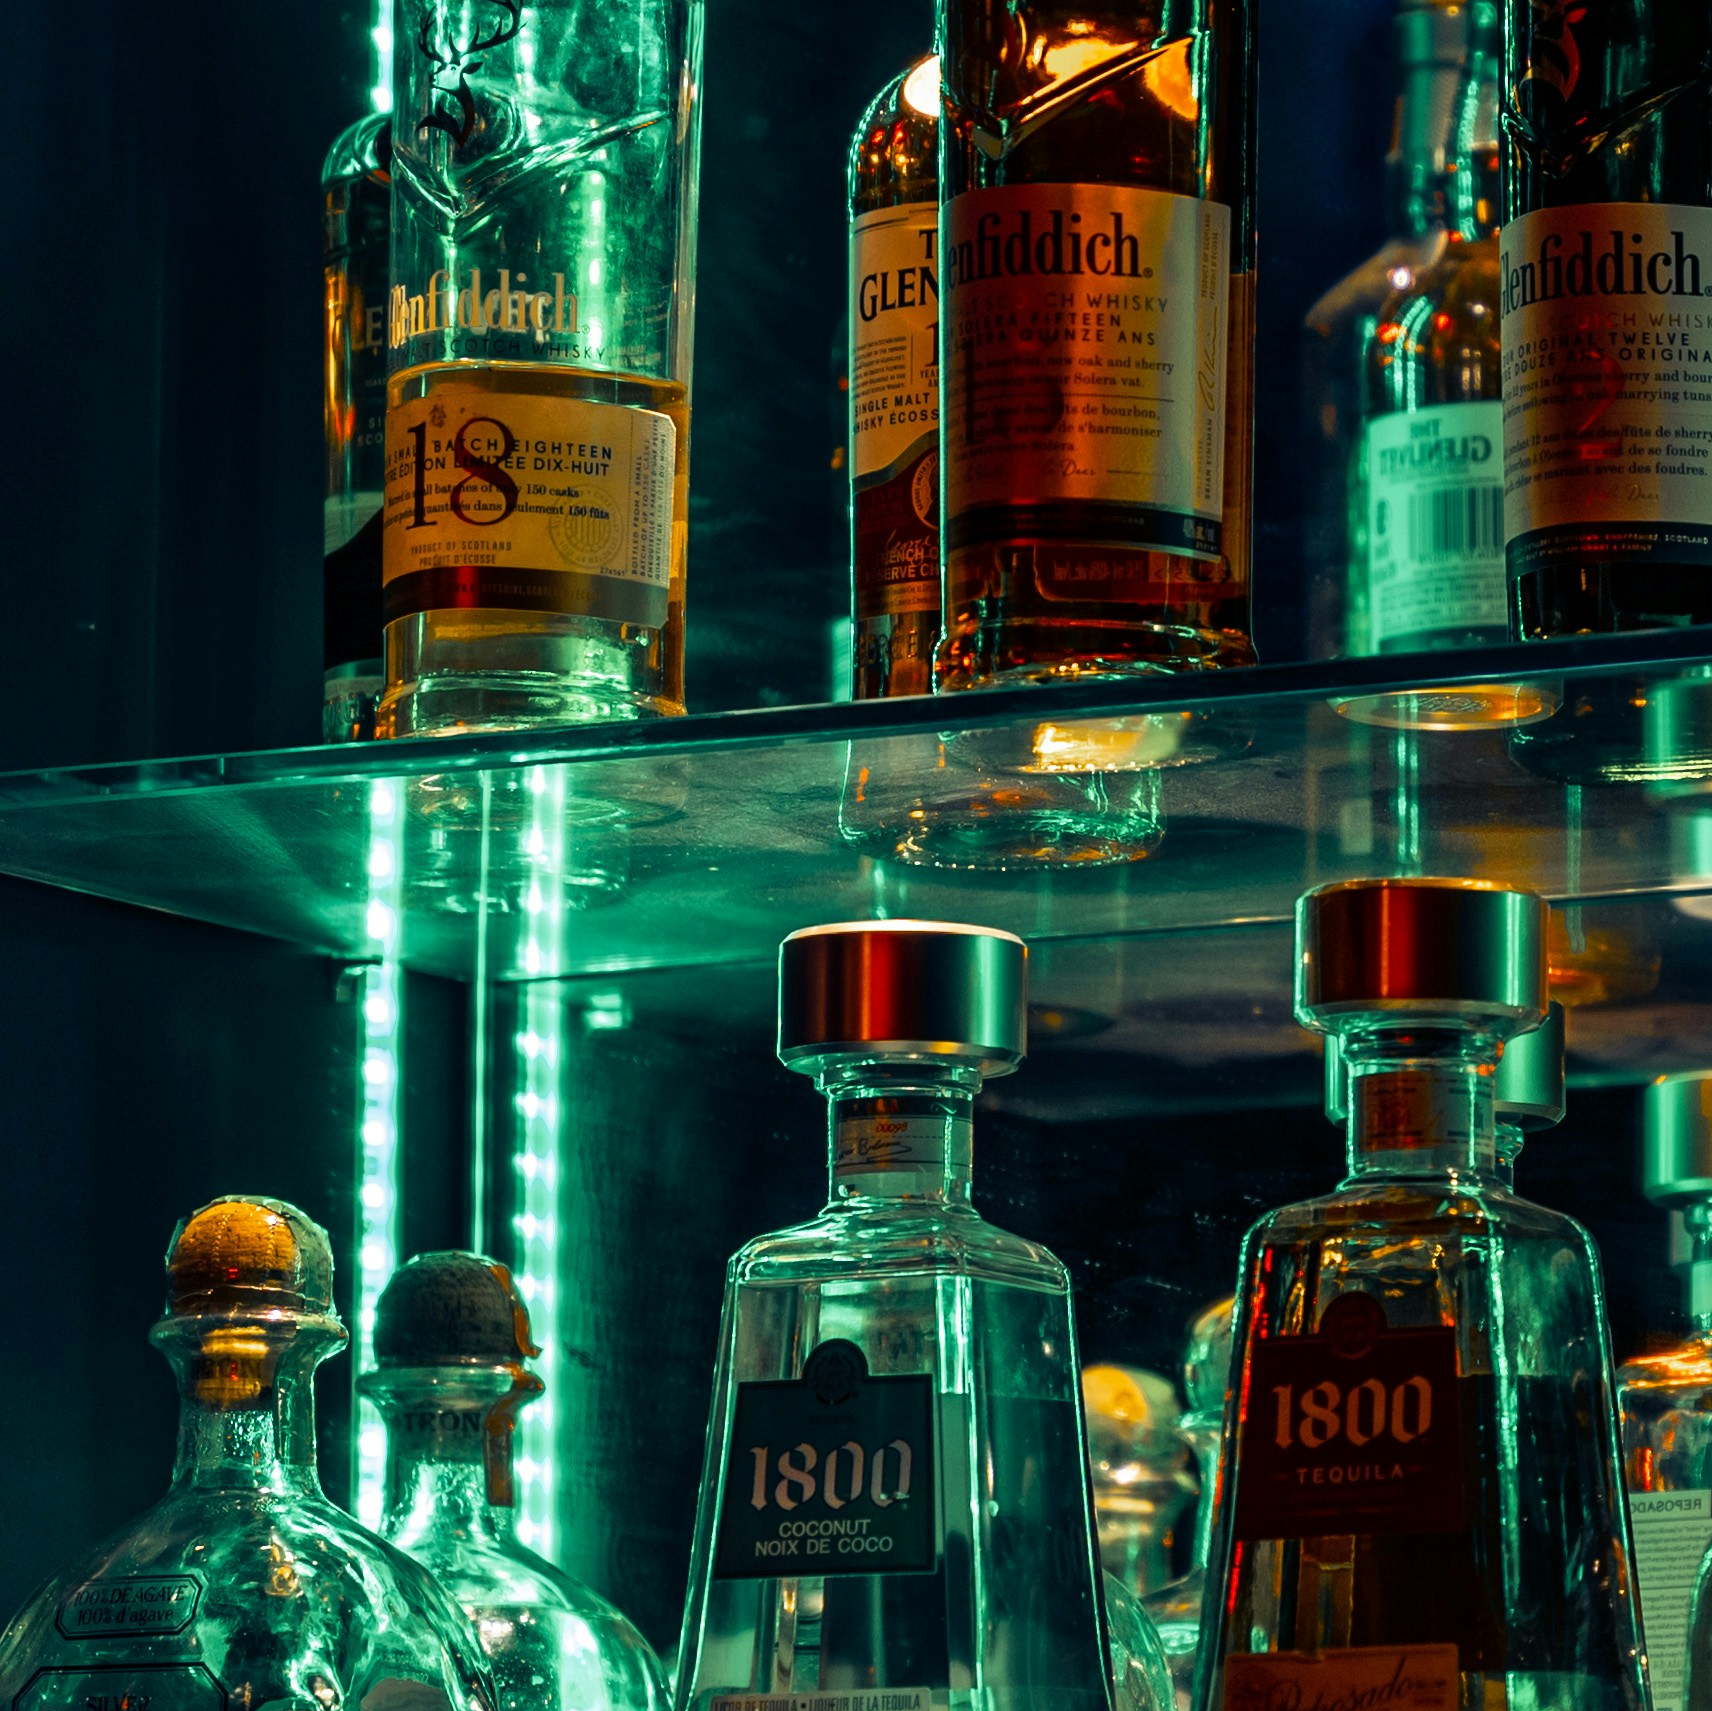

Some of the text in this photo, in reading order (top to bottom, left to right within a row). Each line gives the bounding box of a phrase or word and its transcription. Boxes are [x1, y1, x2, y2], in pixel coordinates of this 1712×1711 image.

[1087, 294, 1168, 313] WHISKY
[1031, 313, 1121, 327] FIFTEEN
[1118, 330, 1156, 346] ANS
[1518, 333, 1690, 356] ORIGINAL TWELVE
[440, 337, 606, 361] SCOTCH WHISKY
[1079, 355, 1174, 375] oak and sherry
[1075, 372, 1114, 388] Solera
[1655, 371, 1679, 382] and
[896, 393, 930, 408] MALT
[1616, 390, 1671, 403] marrying
[1103, 405, 1161, 421] bourbon,
[1082, 423, 1163, 438] s'harmoniser
[1656, 427, 1671, 438] de
[512, 440, 612, 460] EIGHTEEN
[1629, 445, 1709, 458] de fondre
[406, 417, 519, 531] 18
[534, 459, 609, 477] DIX-HUIT
[1595, 462, 1708, 476] avec des foudres.
[527, 483, 579, 499] 150 casks
[568, 505, 610, 520] 150 fûts
[461, 540, 512, 552] SCOTLAND
[1272, 1373, 1434, 1450] 1800
[748, 1438, 914, 1512] 1800
[1295, 1463, 1406, 1486] TEQUILA
[778, 1518, 872, 1538] COCONUT
[755, 1536, 893, 1557] NOIX DE COCO
[116, 1607, 174, 1625] d'agave
[852, 1697, 864, 1711] DE
[866, 1697, 878, 1711] LA
[882, 1694, 920, 1710] TEQUILA
